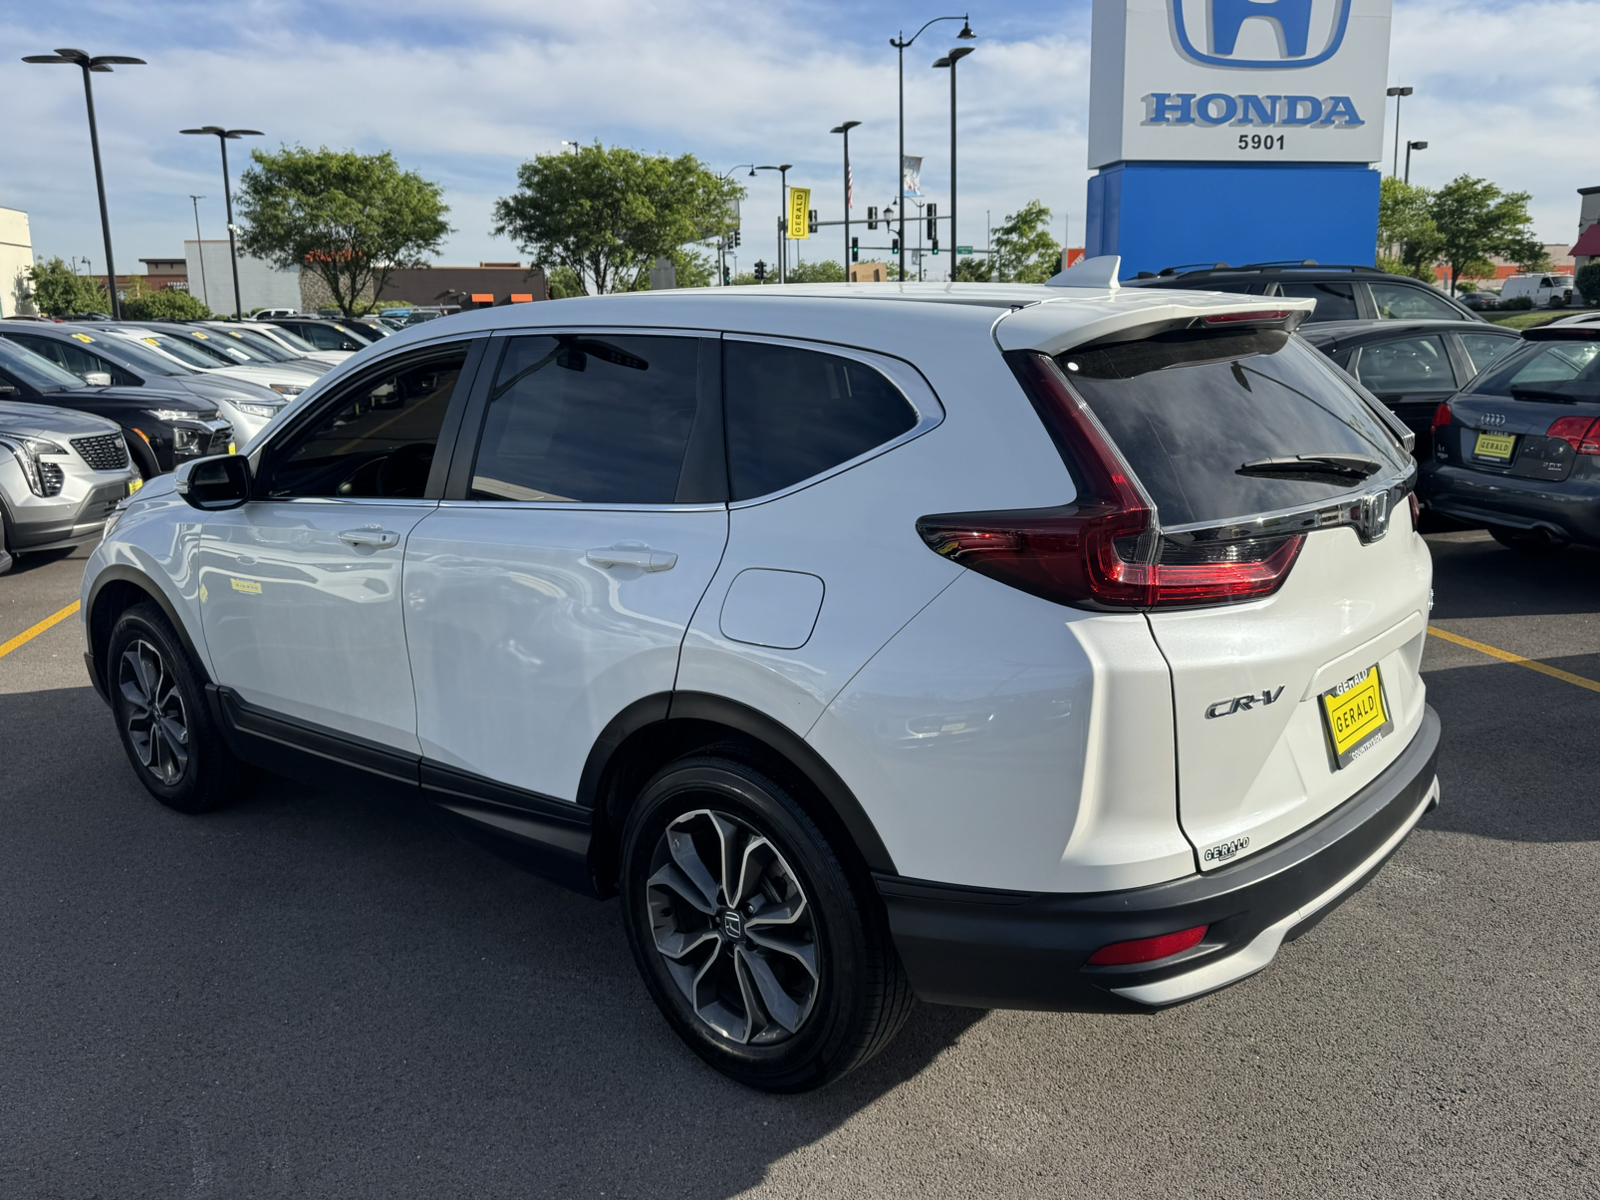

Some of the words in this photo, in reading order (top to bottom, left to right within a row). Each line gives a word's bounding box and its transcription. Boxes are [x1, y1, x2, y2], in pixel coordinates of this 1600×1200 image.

[1140, 92, 1365, 129] HONDA
[1238, 134, 1285, 151] 5901
[795, 194, 803, 233] GERALD
[1480, 442, 1509, 452] GERALD
[1204, 683, 1286, 720] CR-V
[1336, 695, 1375, 733] GERALD
[1204, 836, 1250, 862] GERALD
